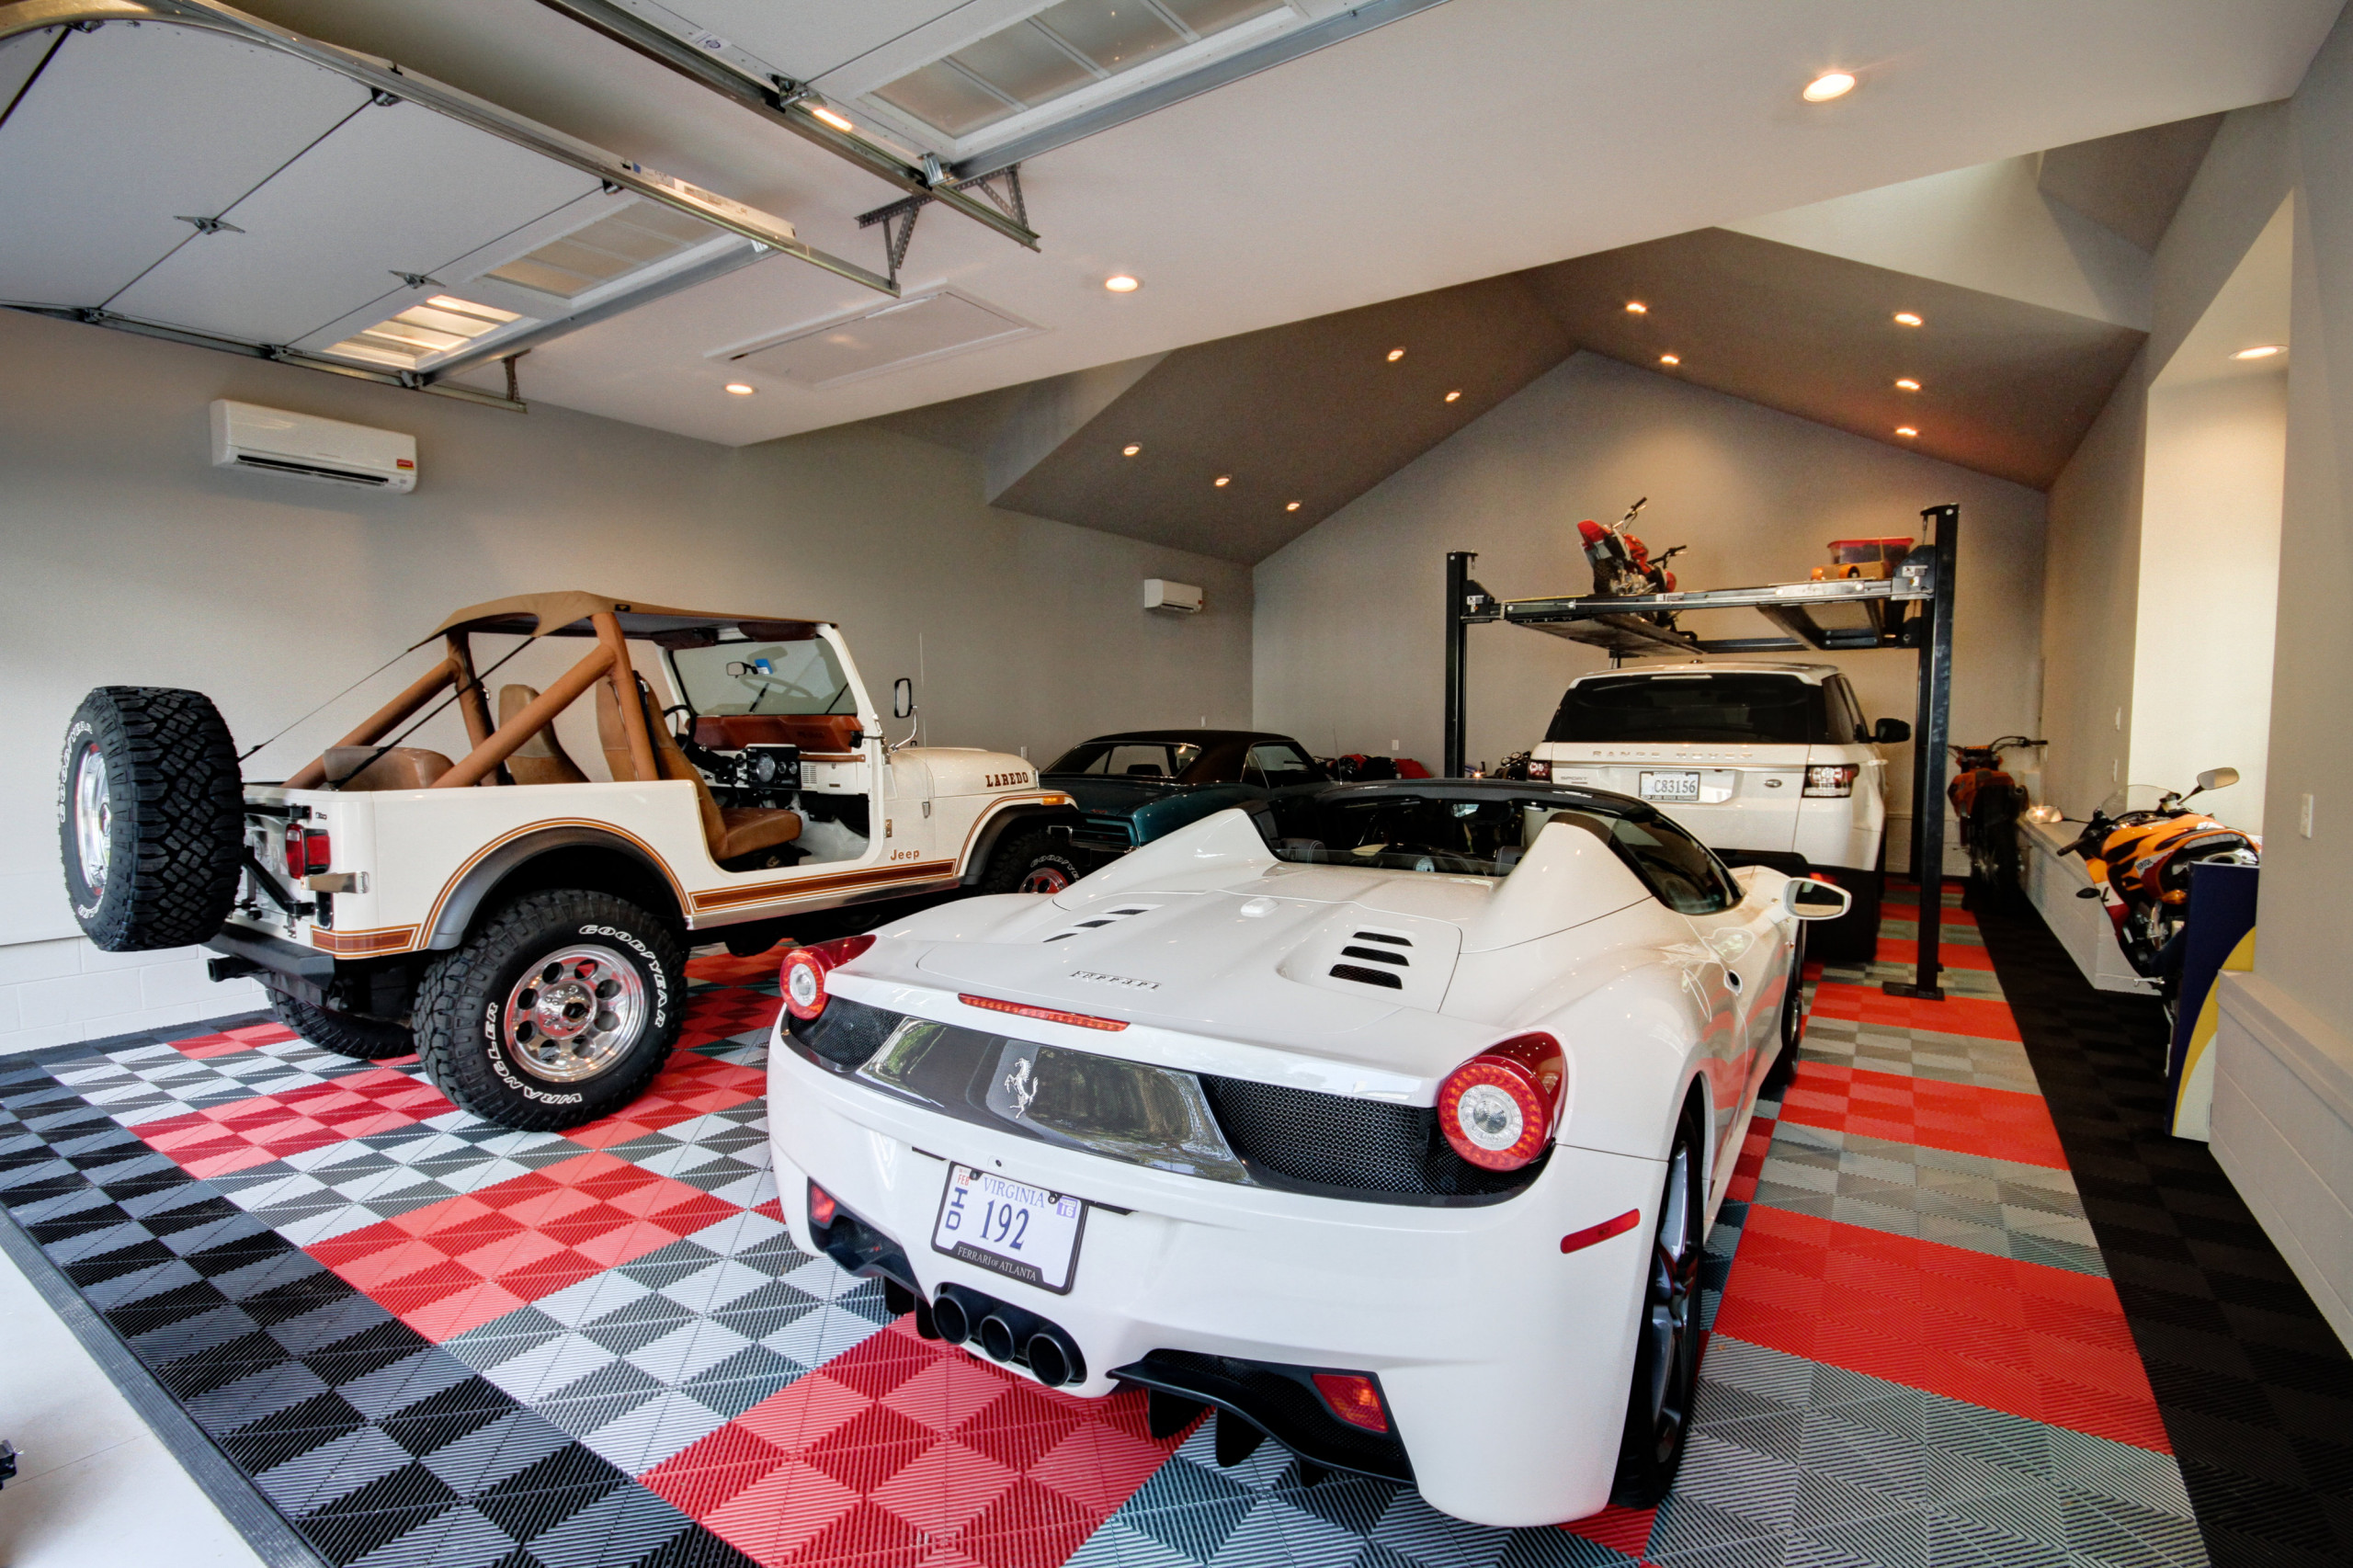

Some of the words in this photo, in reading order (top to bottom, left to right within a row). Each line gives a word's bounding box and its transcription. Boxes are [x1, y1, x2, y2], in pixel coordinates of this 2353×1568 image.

[985, 771, 1029, 788] LAREDO
[1654, 779, 1697, 794] C83156
[890, 848, 920, 861] Jeep
[1030, 855, 1080, 882] GOODYE
[578, 925, 668, 1028] GOODYEAR
[484, 1001, 583, 1104] WRANGLER
[957, 1173, 972, 1187] FEB
[983, 1176, 1045, 1209] VIRGINIA
[1061, 1205, 1074, 1217] 16
[979, 1199, 1030, 1251] 192
[957, 1245, 992, 1267] FERRARI
[998, 1260, 1037, 1281] ATLANTA
